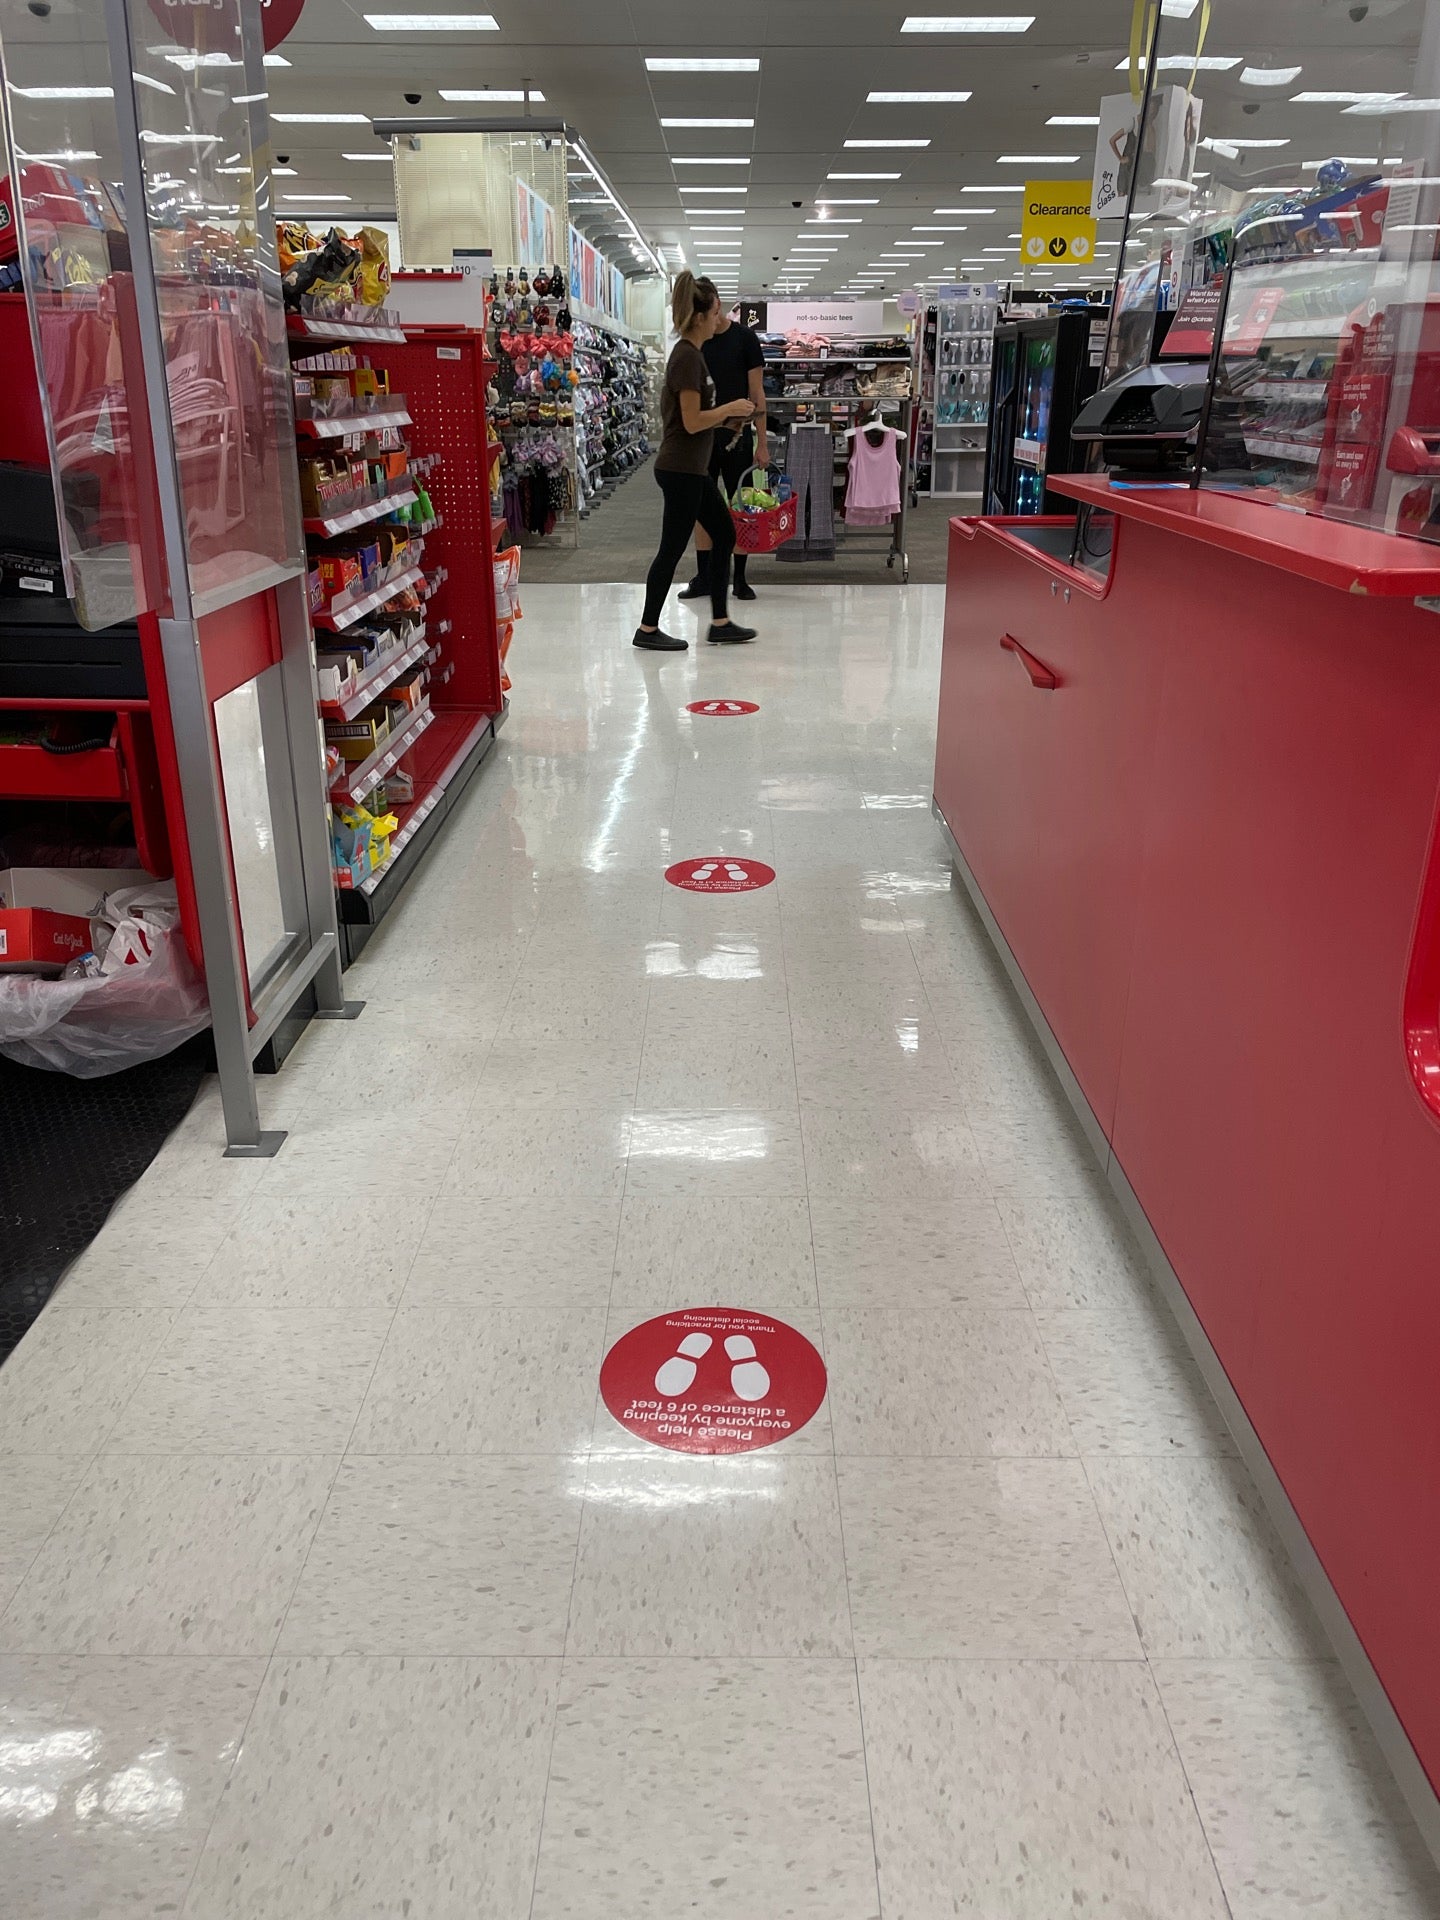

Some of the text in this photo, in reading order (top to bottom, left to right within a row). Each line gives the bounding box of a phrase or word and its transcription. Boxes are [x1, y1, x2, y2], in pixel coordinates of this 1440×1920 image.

[1102, 170, 1113, 182] art
[1097, 190, 1116, 210] class
[1029, 203, 1090, 215] Clearance
[665, 1320, 711, 1329] practicing
[683, 1314, 731, 1323] distancing
[748, 1325, 776, 1333] Thank
[631, 1400, 786, 1417] a distance of 6 feet
[623, 1409, 791, 1429] everyone by keeping
[657, 1423, 753, 1440] Please help
